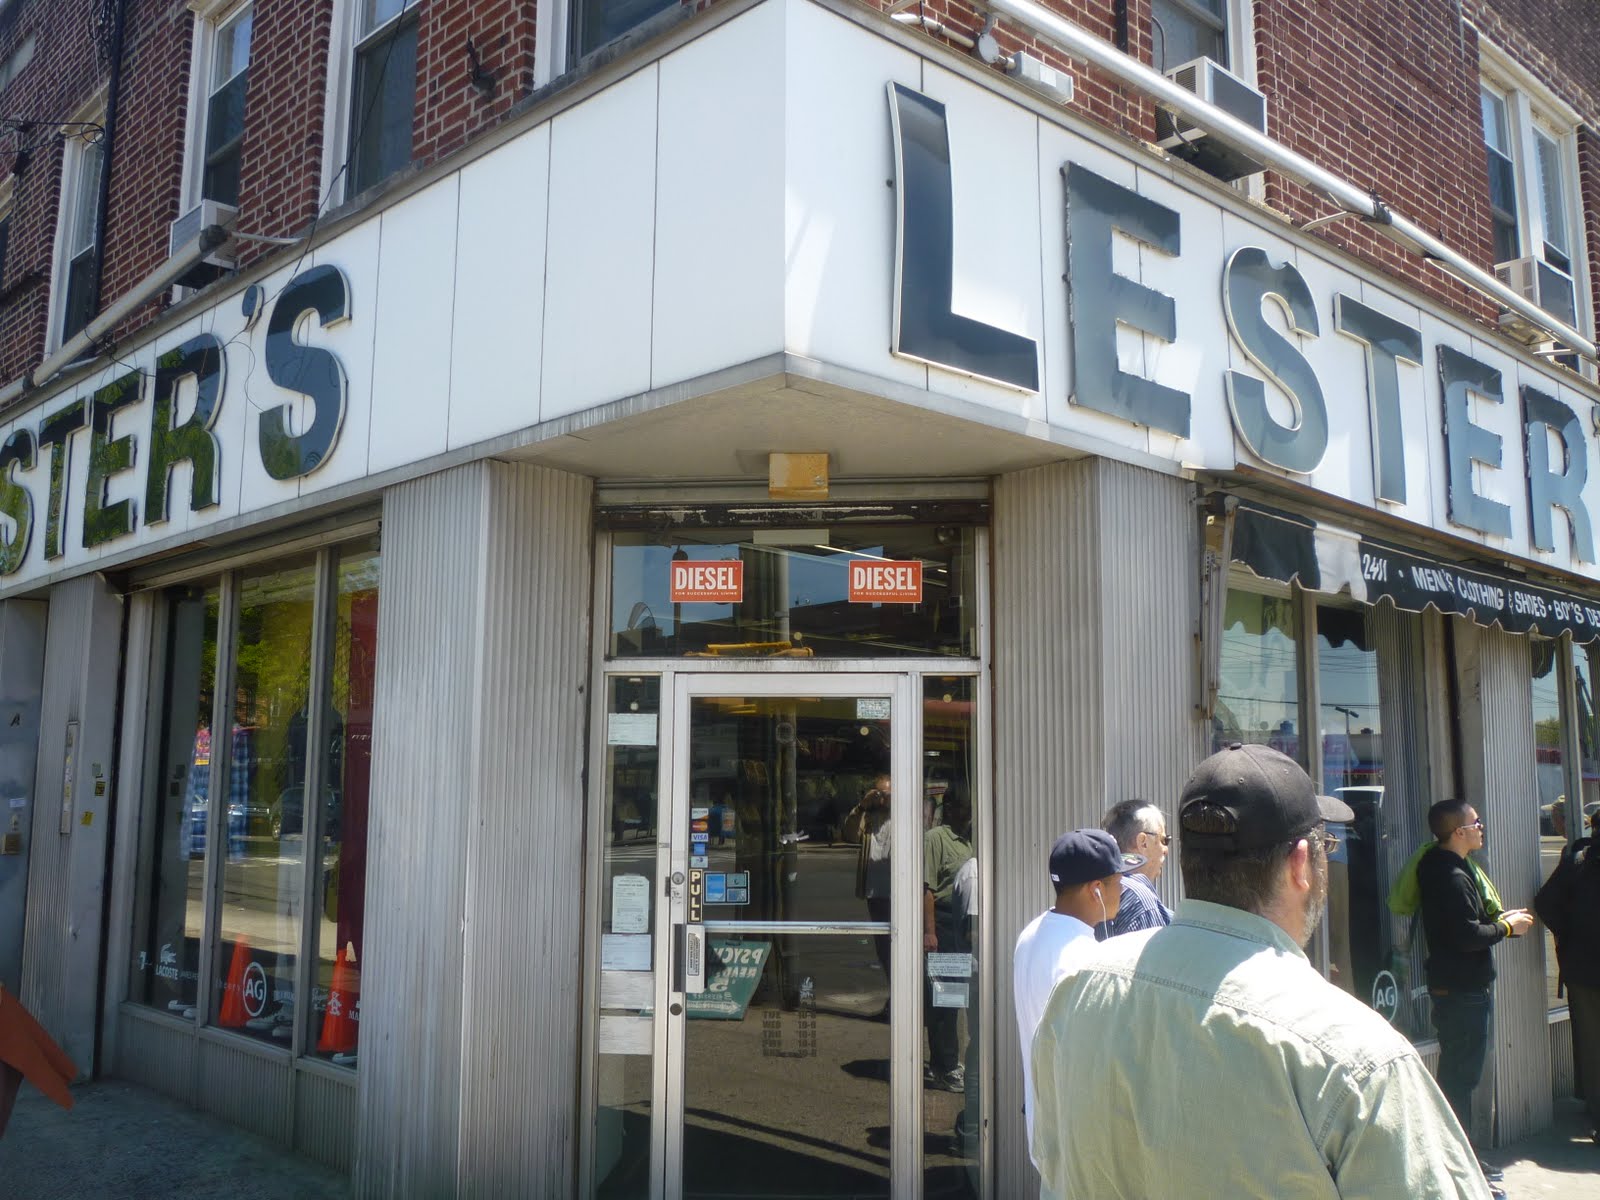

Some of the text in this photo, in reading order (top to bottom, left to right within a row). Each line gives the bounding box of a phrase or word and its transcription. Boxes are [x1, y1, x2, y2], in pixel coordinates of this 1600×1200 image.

[675, 567, 738, 590] DIESEL
[853, 567, 917, 590] DIESEL
[1363, 554, 1387, 582] 2411
[1411, 566, 1455, 594] MEN'S
[1457, 576, 1504, 611] CLOTHING
[1514, 591, 1547, 618] SHOES
[690, 871, 701, 921] PULL
[156, 963, 179, 980] LACOSTE
[245, 978, 264, 1000] AG
[1375, 986, 1395, 1009] AG
